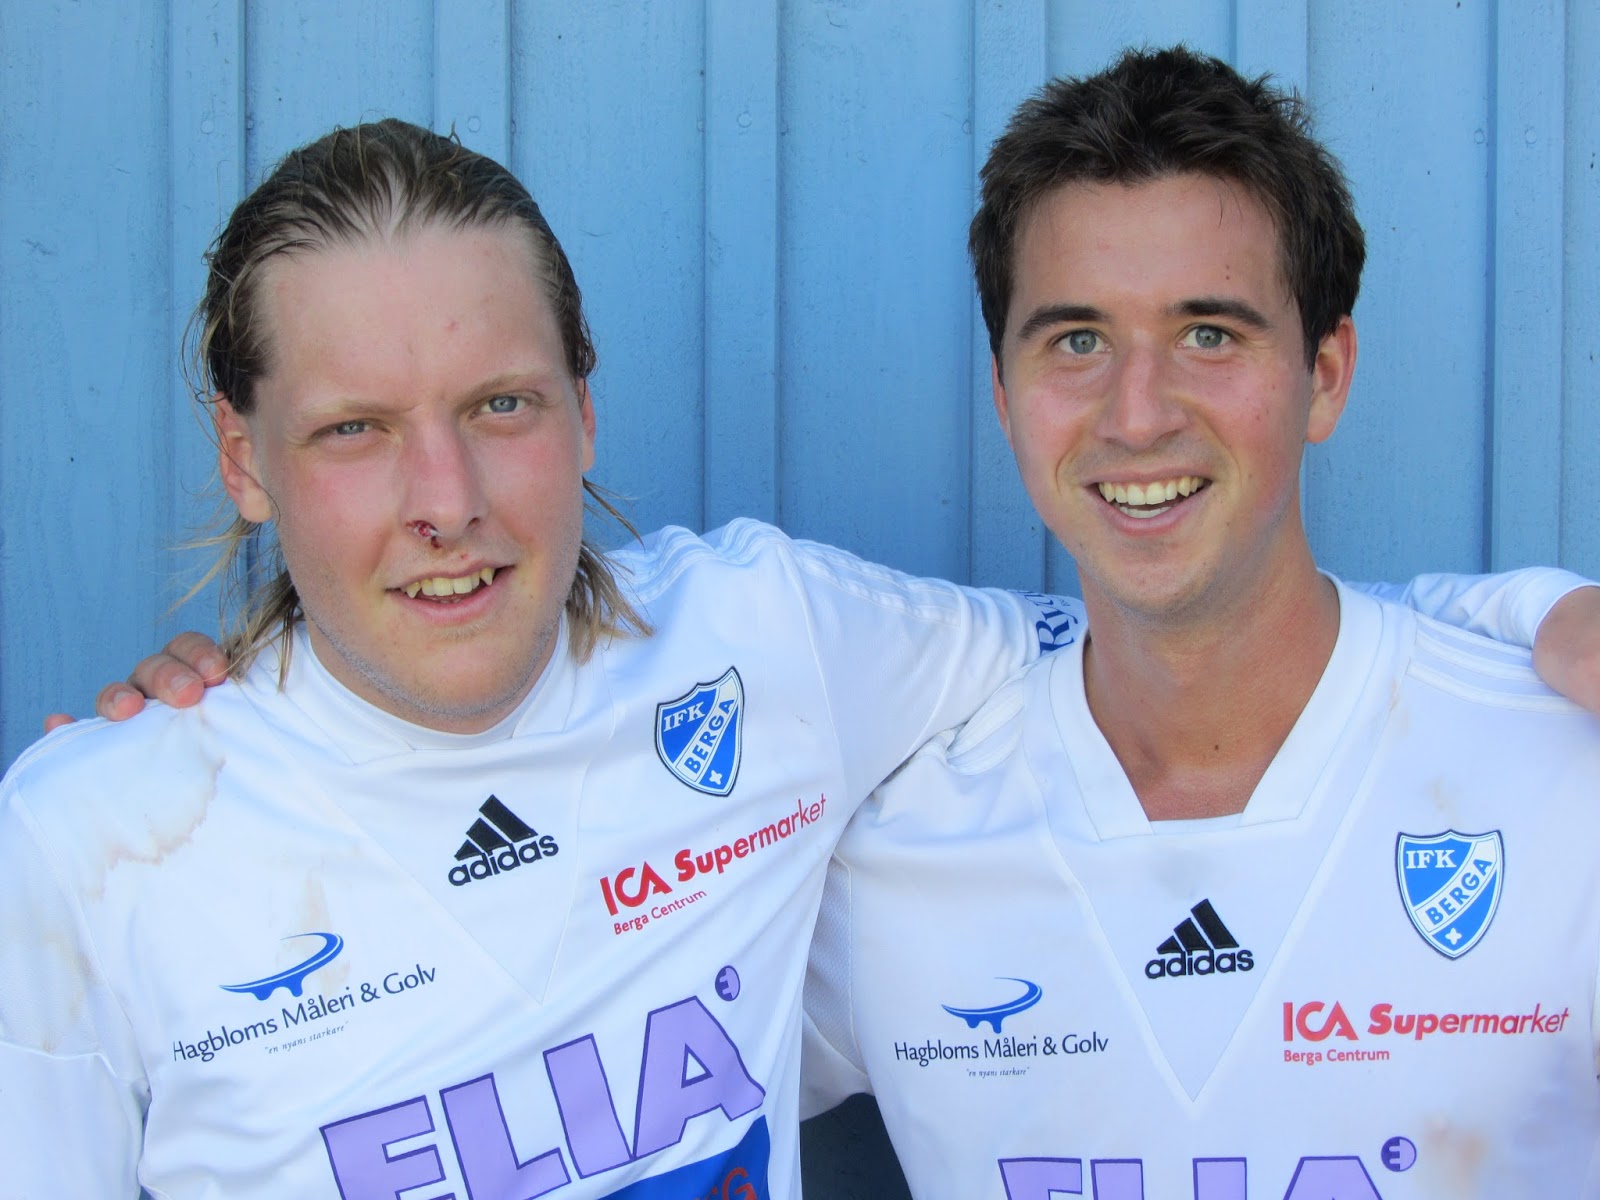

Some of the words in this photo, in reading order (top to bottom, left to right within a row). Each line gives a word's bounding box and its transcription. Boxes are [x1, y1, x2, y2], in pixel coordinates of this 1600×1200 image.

[663, 701, 706, 732] IFK
[684, 698, 735, 774] BERGA
[448, 833, 559, 887] adidas
[600, 861, 673, 916] ICA
[674, 793, 827, 882] Supermarket
[1405, 849, 1457, 869] IFK
[613, 914, 649, 936] Berga
[651, 890, 707, 920] Centrum
[1425, 858, 1492, 925] BERGA
[1144, 949, 1254, 979] adidas
[172, 1017, 278, 1062] Hagbloms
[281, 986, 355, 1028] Måleri
[360, 982, 381, 1003] &
[383, 963, 436, 995] Golv
[1283, 1001, 1359, 1042] ICA
[1367, 1003, 1569, 1041] Supermarket
[895, 1040, 979, 1067] Hagbloms
[984, 1034, 1038, 1059] Måleri
[1042, 1036, 1058, 1055] &
[1062, 1031, 1109, 1054] Golv
[1283, 1050, 1322, 1066] Berga
[1327, 1048, 1390, 1062] Centrum
